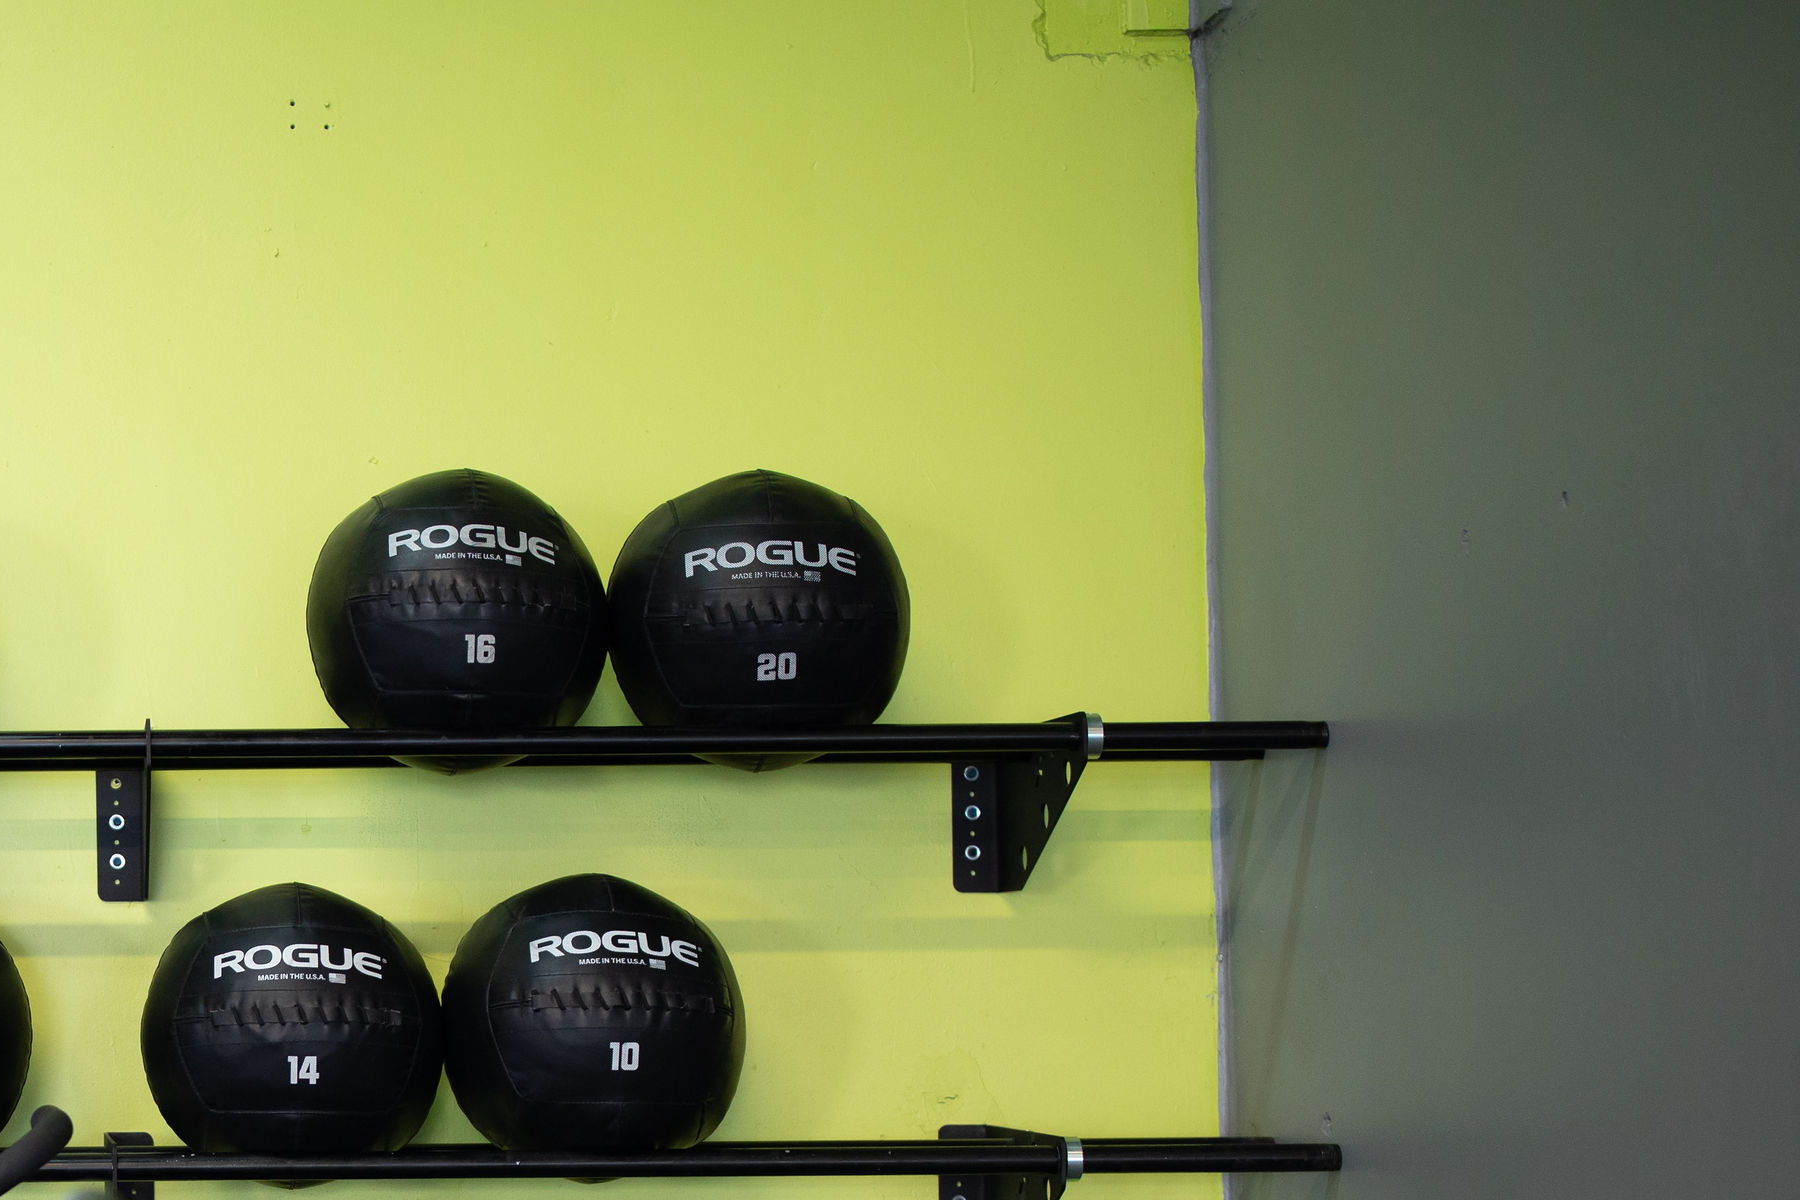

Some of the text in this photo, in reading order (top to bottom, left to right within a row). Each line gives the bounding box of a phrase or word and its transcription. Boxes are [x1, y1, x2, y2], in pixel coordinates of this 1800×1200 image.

[388, 523, 556, 565] ROGUE
[434, 552, 456, 560] MADE
[684, 540, 857, 578] ROGUE
[731, 572, 753, 580] MADE
[465, 634, 495, 663] 16
[757, 653, 796, 680] 20
[213, 943, 383, 979] ROGUE
[529, 930, 699, 968] ROGUE
[578, 958, 601, 966] MADE
[288, 1056, 319, 1084] 14
[610, 1042, 639, 1070] 10
